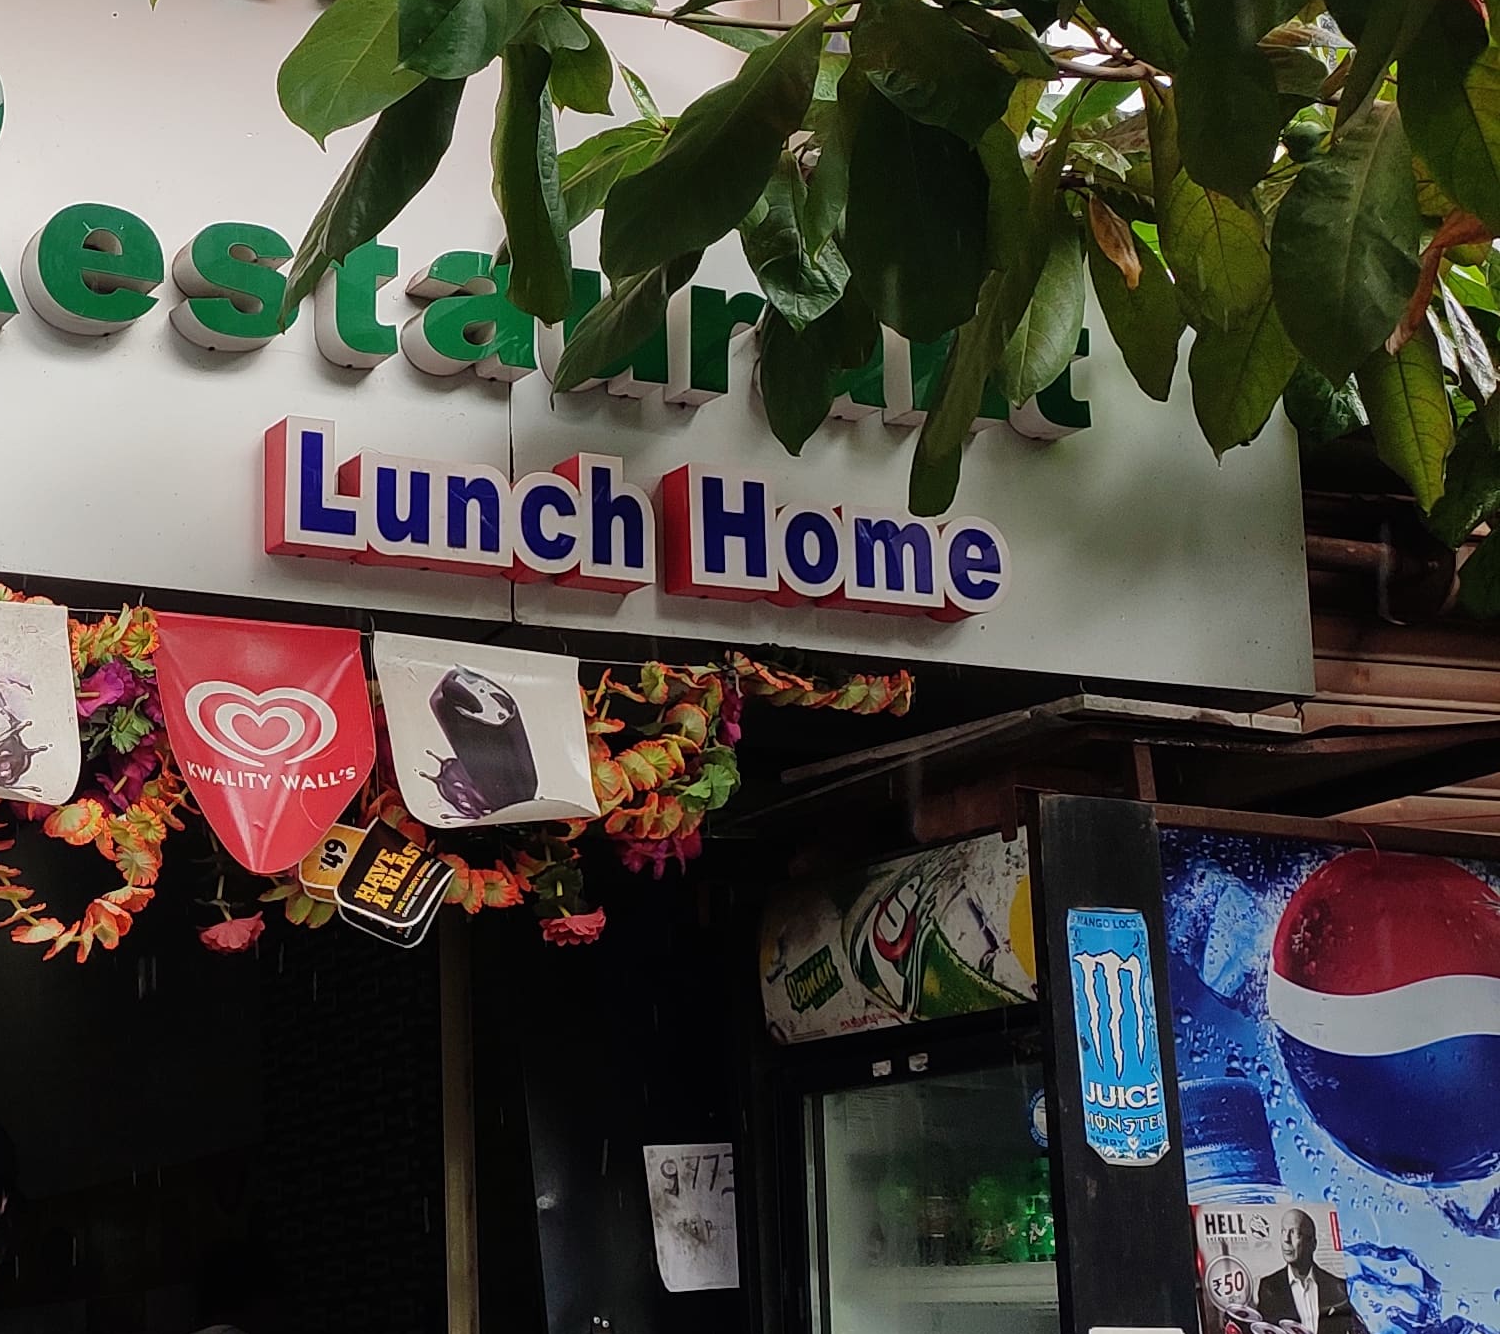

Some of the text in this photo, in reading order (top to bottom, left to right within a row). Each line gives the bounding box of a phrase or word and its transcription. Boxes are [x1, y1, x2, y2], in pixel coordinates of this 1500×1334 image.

[297, 431, 1001, 600] Lunch Home
[186, 760, 357, 792] KWALITY WALL'S
[354, 848, 397, 903] HAVE
[1086, 1082, 1159, 1108] JUICE
[1204, 1213, 1246, 1235] HELL
[1212, 1270, 1245, 1297] ₹50
